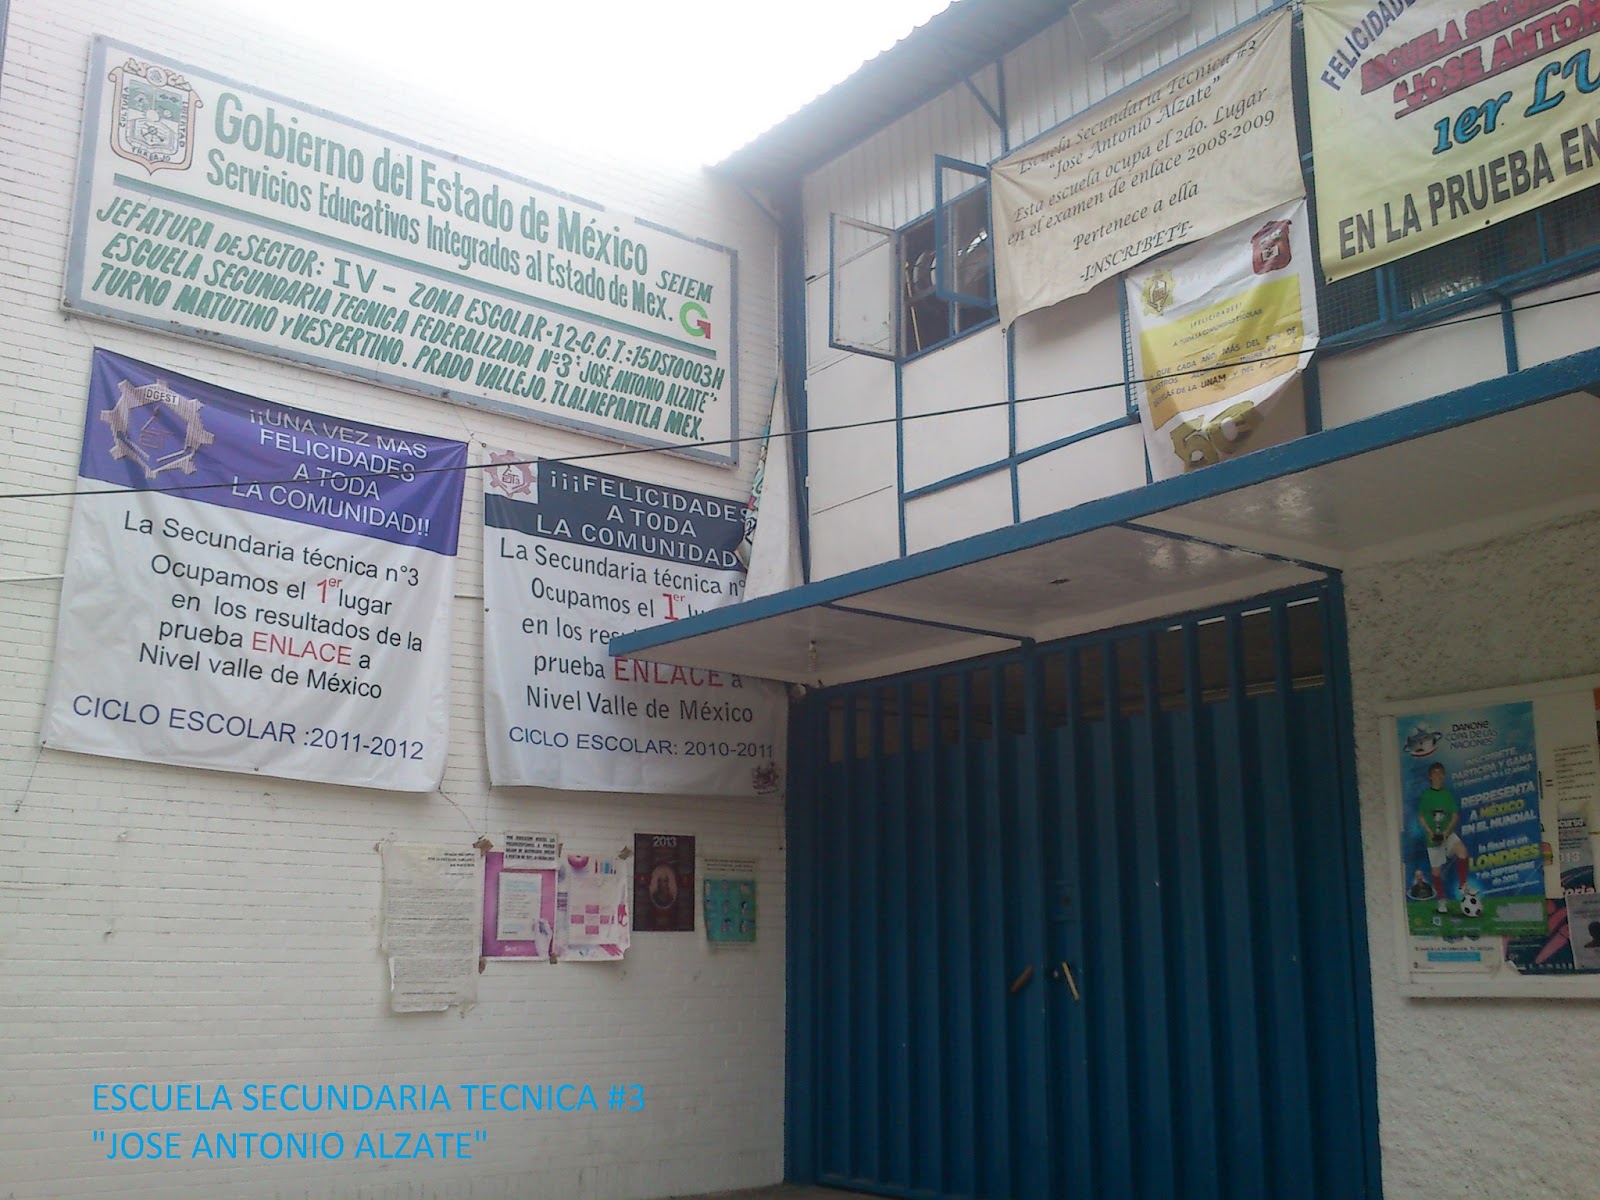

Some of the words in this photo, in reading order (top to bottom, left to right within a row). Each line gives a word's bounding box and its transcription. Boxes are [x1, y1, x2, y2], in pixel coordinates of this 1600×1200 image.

[1014, 199, 1045, 222] Esta
[1049, 168, 1100, 206] escuela
[1105, 146, 1152, 174] ocupa
[1156, 128, 1174, 152] el
[1213, 87, 1268, 125] Lugar
[1019, 135, 1071, 174] Escuela
[1076, 89, 1161, 145] Secundaria
[1088, 116, 1152, 159] Antonio
[215, 92, 365, 184] Gobierno
[372, 146, 413, 200] del
[421, 159, 514, 232] Estado
[520, 196, 550, 243] de
[557, 206, 649, 276] México
[1007, 230, 1025, 246] en
[1029, 215, 1045, 237] el
[1046, 192, 1104, 229] examen
[1108, 177, 1127, 199] de
[1131, 153, 1182, 187] enlace
[1187, 110, 1275, 161] 2008-2009
[1339, 209, 1376, 260] EN
[1384, 193, 1422, 243] LA
[1427, 142, 1555, 227] PRUEBA
[206, 148, 313, 212] Servicios
[318, 181, 420, 244] Educativos
[427, 214, 520, 271] Integrados
[525, 249, 542, 284] al
[547, 252, 606, 302] Estado
[609, 273, 628, 308] de
[1073, 205, 1148, 251] Pertenece
[1153, 198, 1164, 213] a
[1168, 180, 1200, 207] ella
[96, 196, 215, 250] JEFATURA
[332, 256, 377, 294] IV
[408, 281, 465, 319] ZONA
[655, 270, 714, 304] SEIEM
[101, 232, 204, 281] ESCUELA
[203, 259, 333, 315] SECUNDARIA
[331, 292, 410, 334] TECNICA
[410, 313, 535, 369] FEDERALIZADA
[610, 369, 667, 403] ANTONIO
[92, 262, 173, 307] TURNO
[172, 283, 279, 331] MATUTINO
[411, 344, 475, 382] PRADO
[549, 379, 663, 430] TLALNEPANTLA
[146, 388, 178, 404] DGEST
[1200, 373, 1227, 389] UNAM
[258, 428, 416, 484] FELICIDADES
[322, 422, 371, 448] VEZ
[376, 435, 429, 460] MAS
[230, 475, 264, 502] LA
[268, 485, 431, 537] COMUNIDAD!!
[292, 463, 311, 484] A
[315, 467, 381, 502] TODA
[124, 510, 153, 535] La
[162, 517, 295, 562] Secundaria
[302, 546, 379, 579] técnica
[536, 514, 573, 539] LA
[580, 524, 739, 568] COMUNIDAD
[606, 504, 624, 525] A
[628, 508, 697, 538] TODA
[151, 554, 279, 595] Ocupamos
[286, 580, 306, 601] el
[338, 588, 393, 616] lugar
[500, 537, 528, 562] La
[534, 544, 647, 584] Secundaria
[653, 568, 723, 595] técnica
[171, 592, 202, 612] en
[213, 595, 248, 620] los
[254, 607, 371, 642] resultados
[376, 626, 402, 648] de
[406, 631, 424, 653] la
[531, 576, 631, 615] Ocupamos
[637, 598, 655, 619] el
[158, 620, 244, 649] prueba
[251, 631, 353, 667] ENLACE
[358, 654, 372, 671] a
[522, 617, 549, 636] en
[556, 616, 583, 642] los
[138, 642, 201, 672] Nivel
[208, 657, 263, 681] valle
[270, 664, 300, 686] de
[306, 668, 383, 699] México
[533, 654, 606, 680] prueba
[614, 656, 724, 689] ENLACE
[731, 673, 744, 689] a
[72, 694, 161, 727] CICLO
[168, 707, 298, 746] ESCOLAR
[526, 685, 582, 712] Nivel
[586, 690, 639, 718] Valle
[646, 698, 671, 720] de
[679, 699, 754, 723] México
[508, 726, 569, 749] CICLO
[576, 733, 678, 756] ESCOLAR:
[684, 741, 774, 760] 2010-2011
[653, 836, 678, 848] 2013
[1490, 809, 1538, 829] MUNDIAL
[1468, 843, 1541, 873] LONDRES
